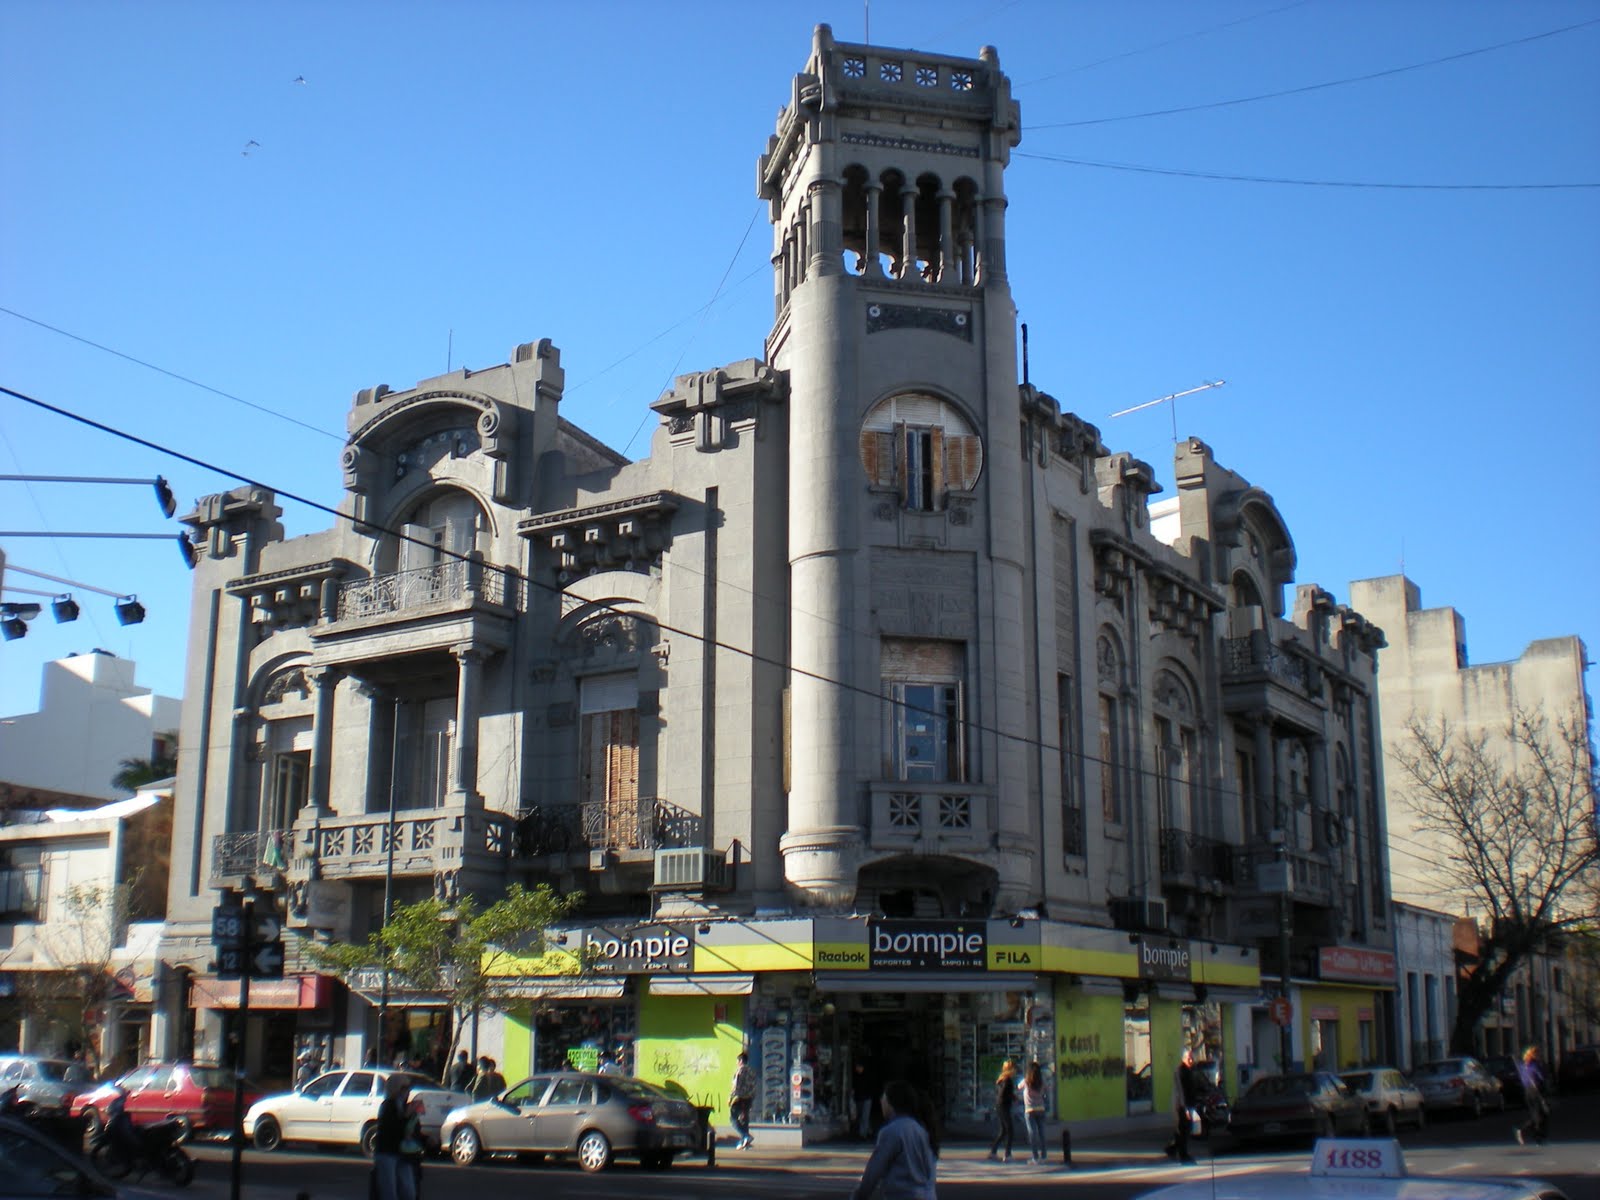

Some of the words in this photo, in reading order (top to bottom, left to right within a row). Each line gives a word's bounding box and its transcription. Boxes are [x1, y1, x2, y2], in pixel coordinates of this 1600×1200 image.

[216, 917, 238, 936] 58
[586, 930, 690, 963] bompie
[873, 926, 983, 959] bompie
[223, 952, 237, 969] 12
[818, 951, 865, 963] Reebok
[996, 952, 1031, 963] FILA
[1143, 941, 1189, 971] bompie
[1327, 1149, 1382, 1169] 1188
